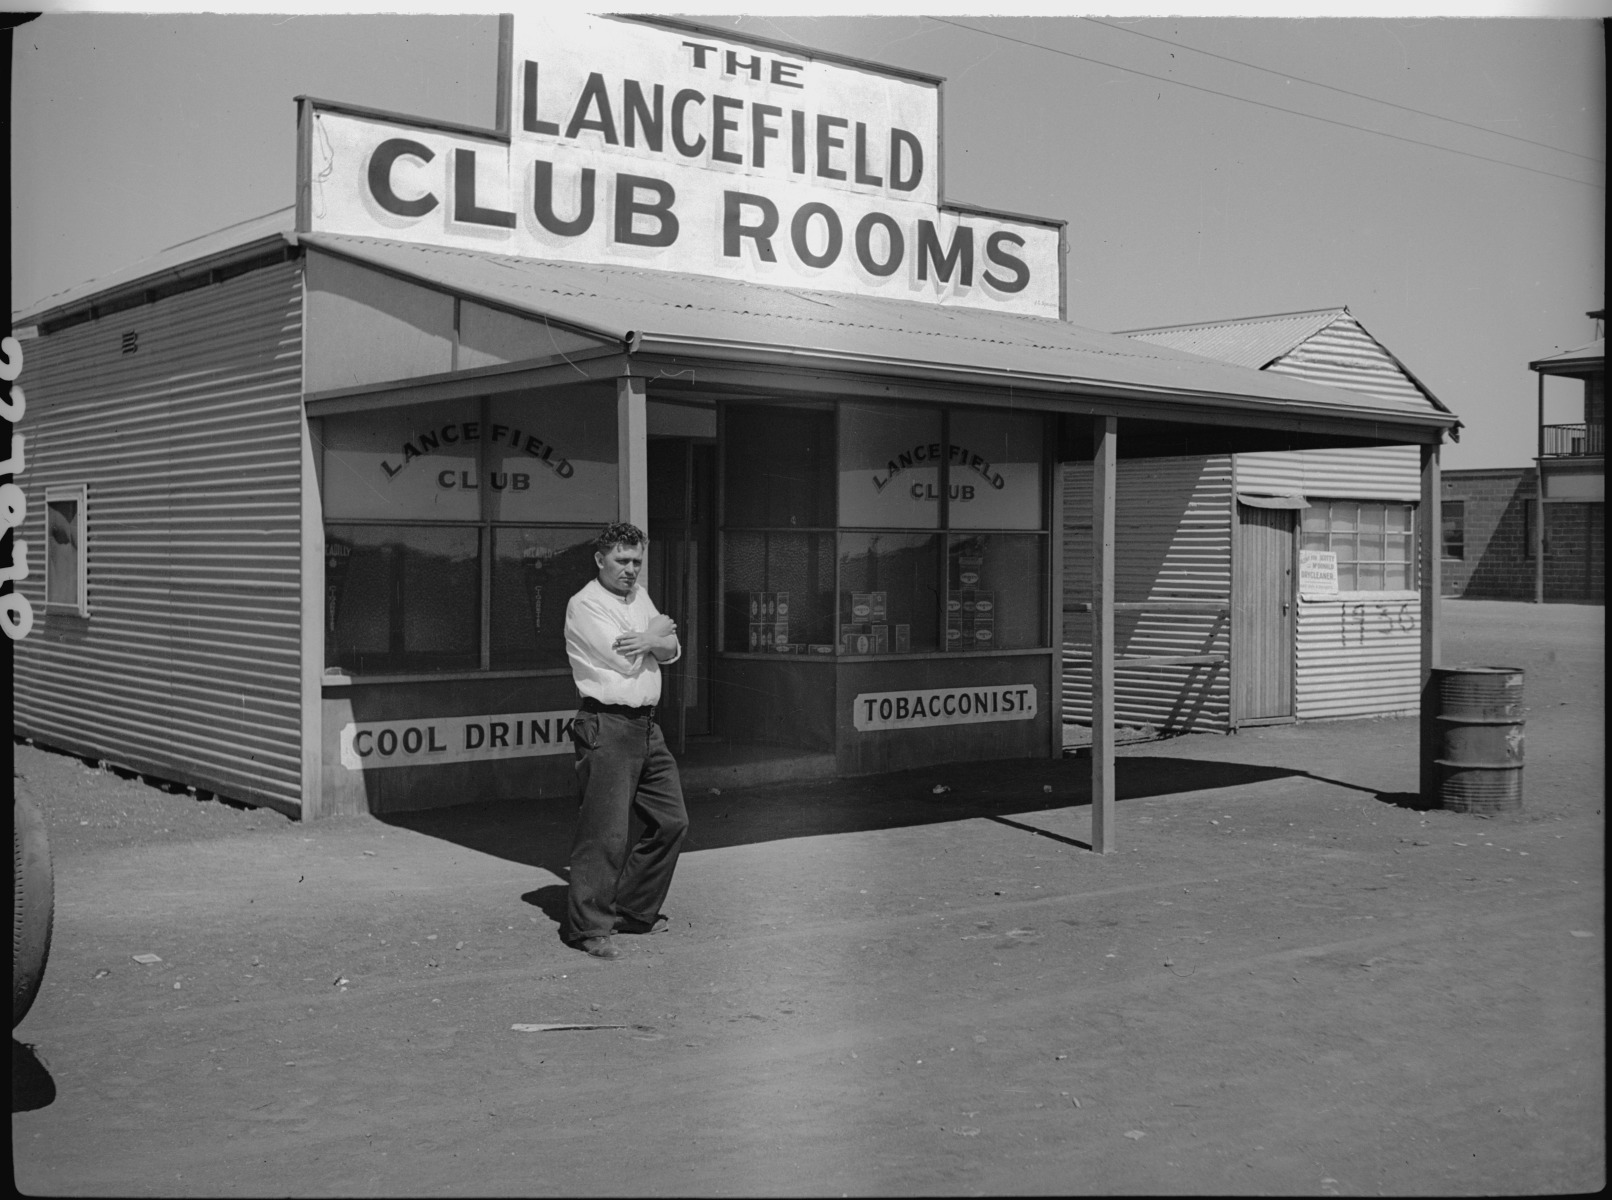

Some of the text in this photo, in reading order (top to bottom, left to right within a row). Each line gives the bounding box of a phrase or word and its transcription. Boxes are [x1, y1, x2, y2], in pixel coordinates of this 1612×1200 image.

[682, 40, 804, 89] THE
[522, 59, 924, 193] LANCEFIELD
[367, 137, 1031, 294] CLUB ROOMS
[437, 469, 531, 492] CLUB
[910, 482, 976, 501] CLUB
[863, 689, 1033, 722] TOBACCONIST.
[352, 725, 448, 758] COOL
